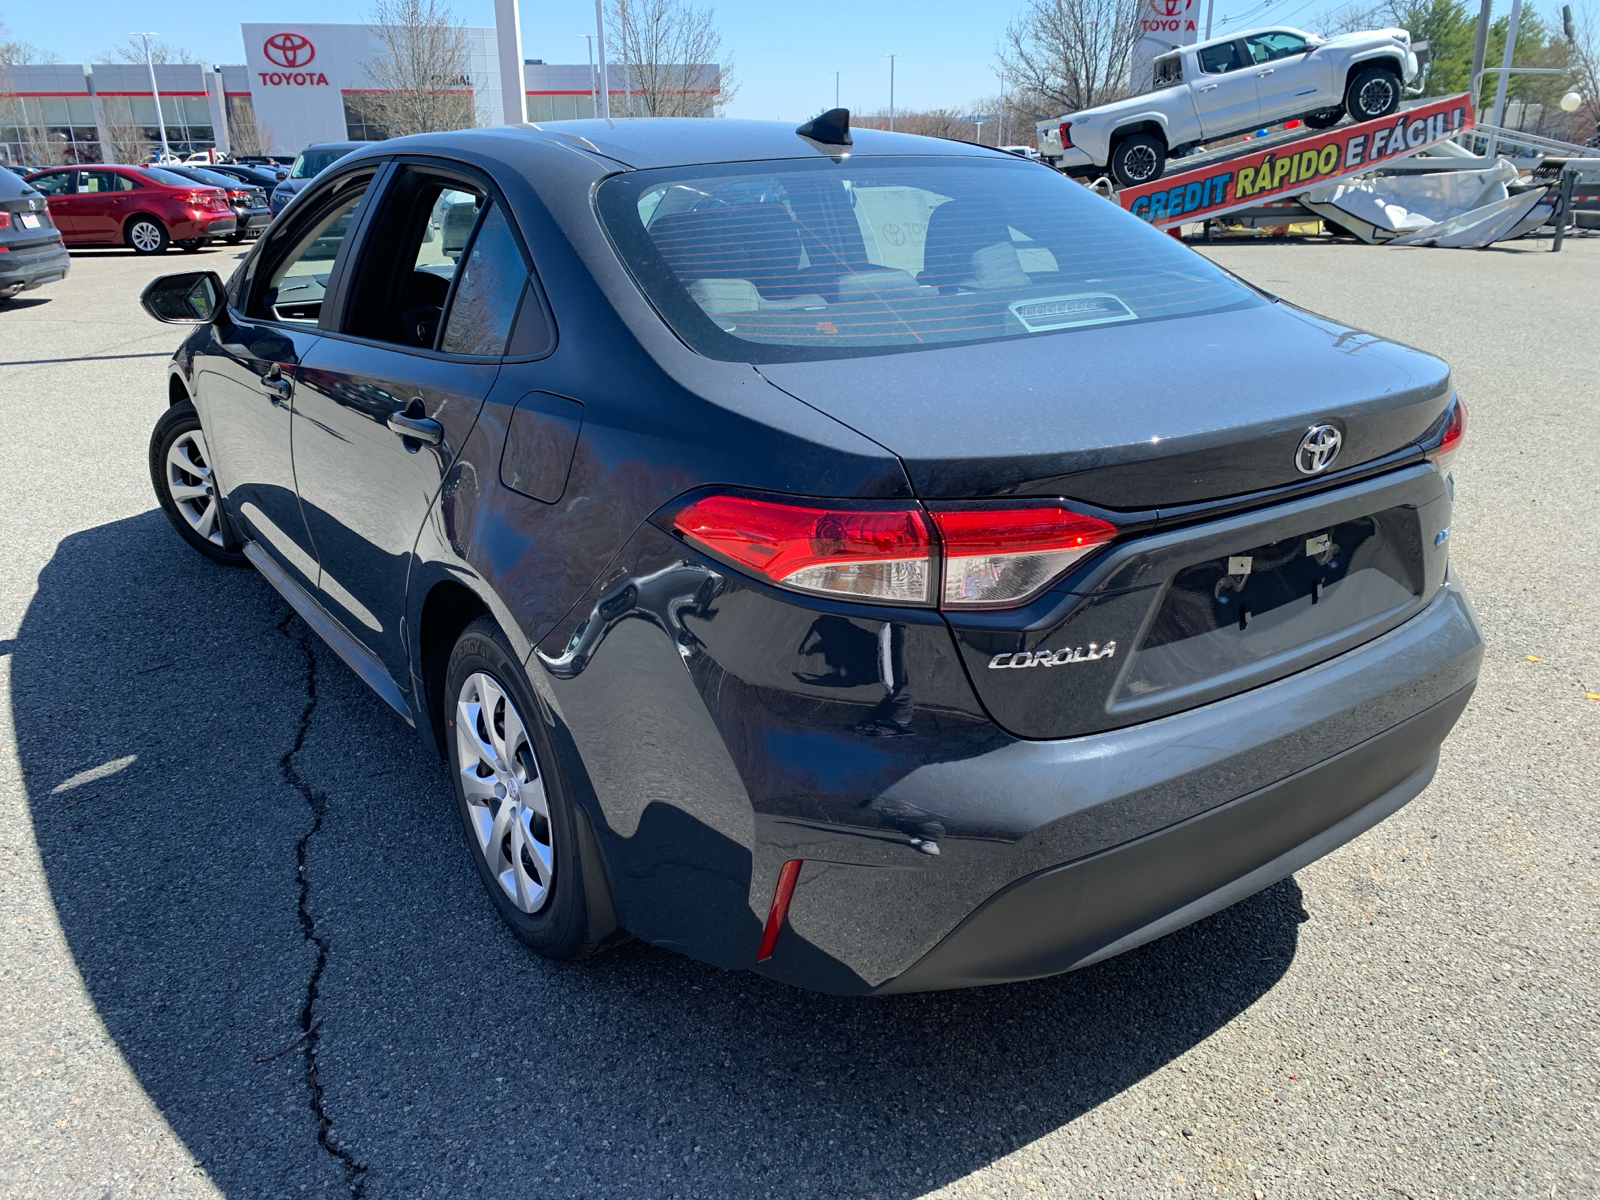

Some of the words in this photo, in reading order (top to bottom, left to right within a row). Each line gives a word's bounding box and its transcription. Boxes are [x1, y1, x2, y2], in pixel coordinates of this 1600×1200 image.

[1142, 19, 1196, 31] TOYOA
[257, 72, 329, 86] TOYOTA
[1130, 171, 1234, 222] CREDIT
[1234, 142, 1341, 199] RÁPIDO
[1345, 134, 1370, 168] E
[1370, 106, 1466, 160] FÁCIL!
[988, 640, 1117, 669] COROLLA
